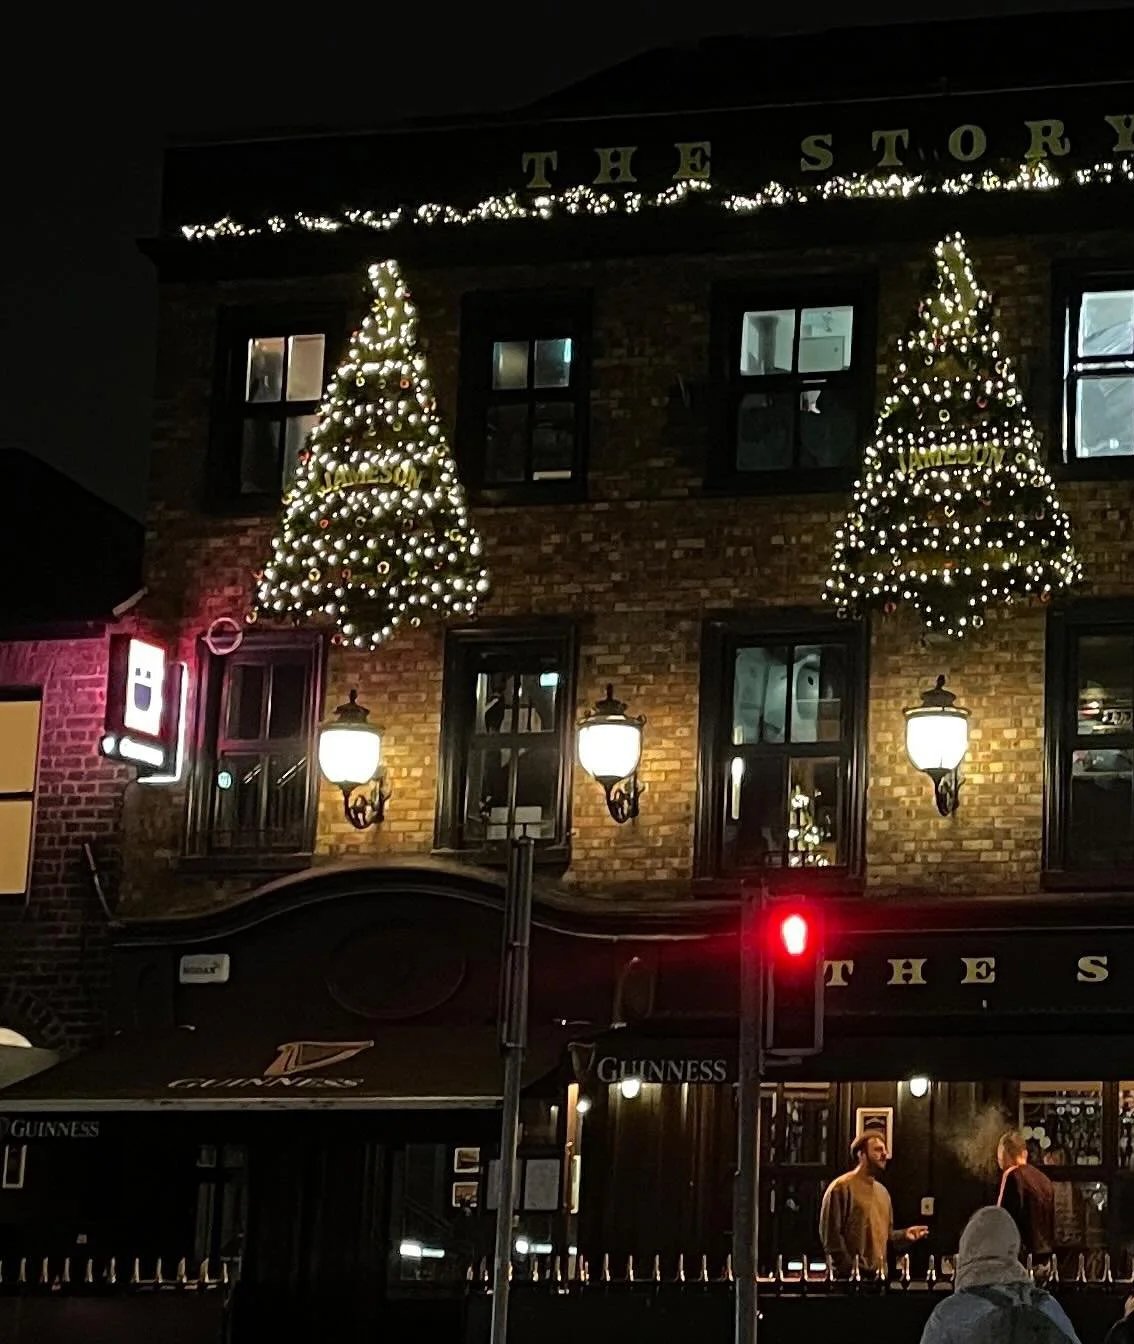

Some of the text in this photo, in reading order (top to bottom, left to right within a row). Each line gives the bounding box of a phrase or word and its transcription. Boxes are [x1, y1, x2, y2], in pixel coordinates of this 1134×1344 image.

[521, 140, 713, 189] THE
[898, 440, 1006, 476] JAMESON
[824, 955, 996, 987] THE
[597, 1057, 728, 1083] GUINNESS
[10, 1119, 100, 1138] GUINNESS
